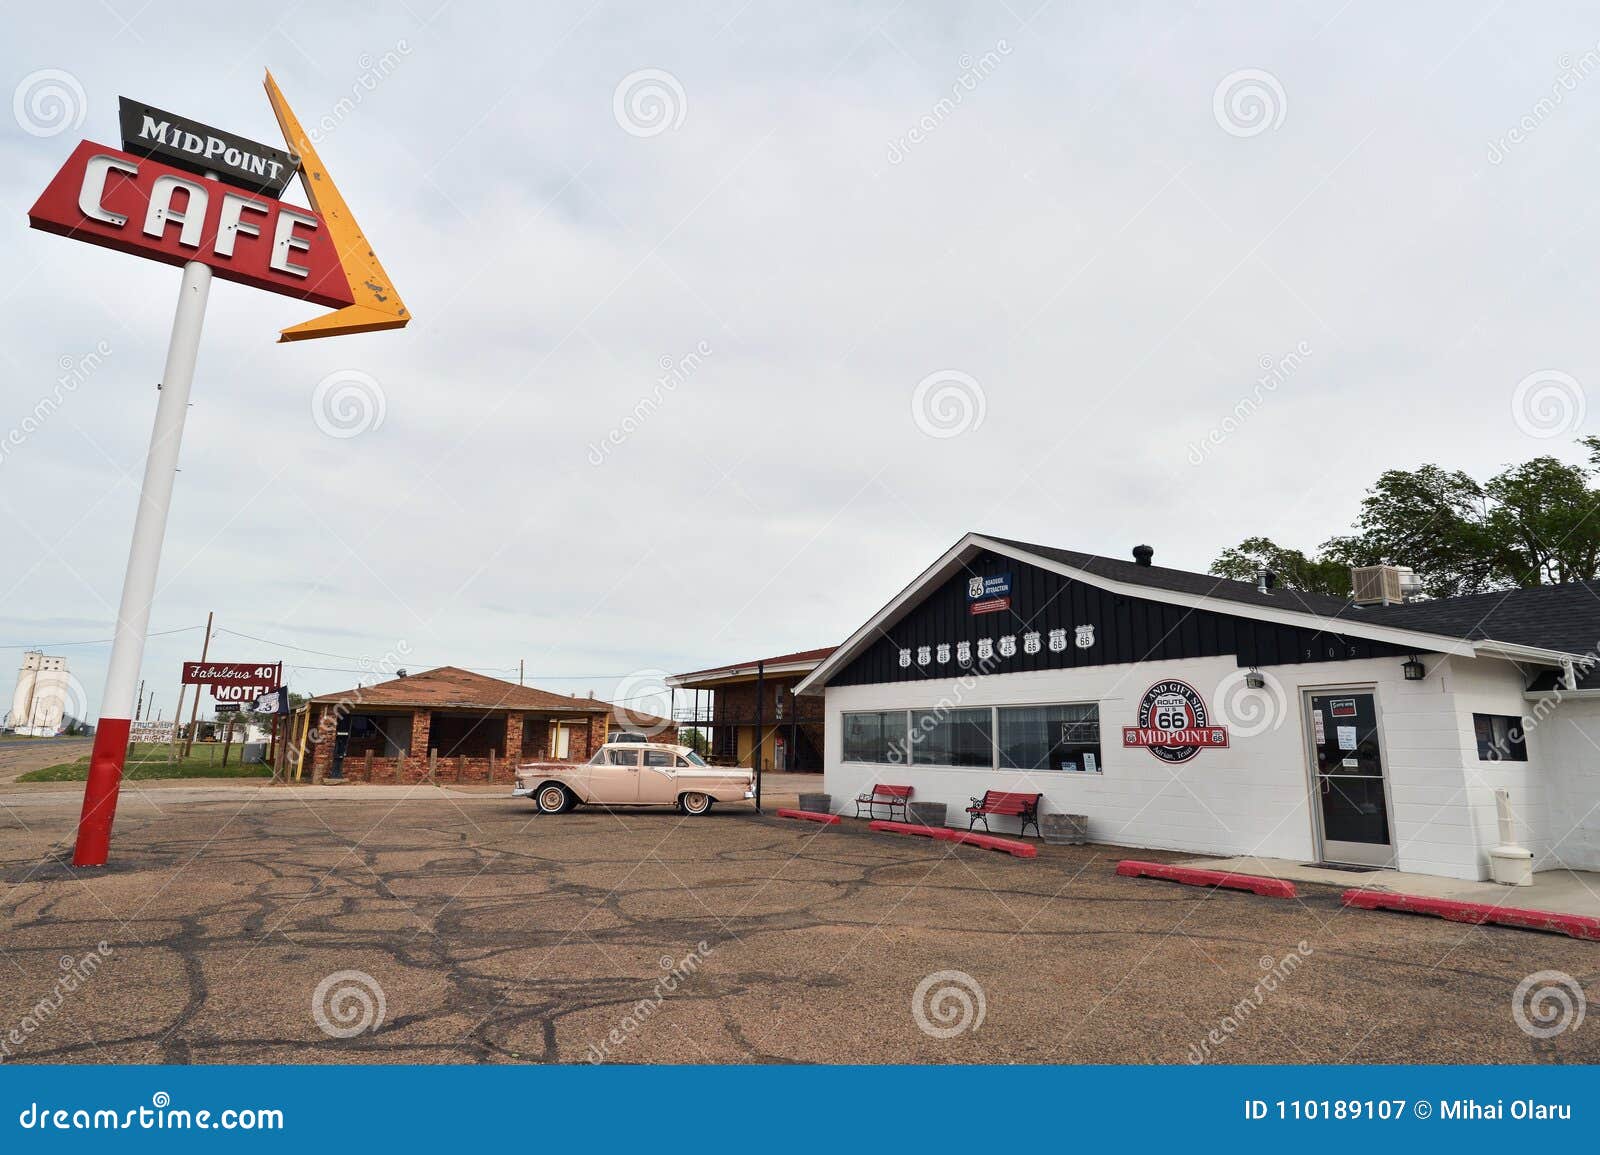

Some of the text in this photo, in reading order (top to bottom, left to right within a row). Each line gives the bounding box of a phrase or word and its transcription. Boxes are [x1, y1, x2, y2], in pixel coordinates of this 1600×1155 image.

[138, 115, 284, 181] MIDPOINT
[77, 154, 319, 278] CAFE
[970, 584, 983, 597] 66
[190, 665, 273, 679] Fabulous 40
[1140, 683, 1205, 728] CAFE AND GIFT SHOP
[1156, 698, 1185, 706] ROUTE
[1158, 712, 1185, 729] 66
[1138, 729, 1210, 745] MIDPOINT
